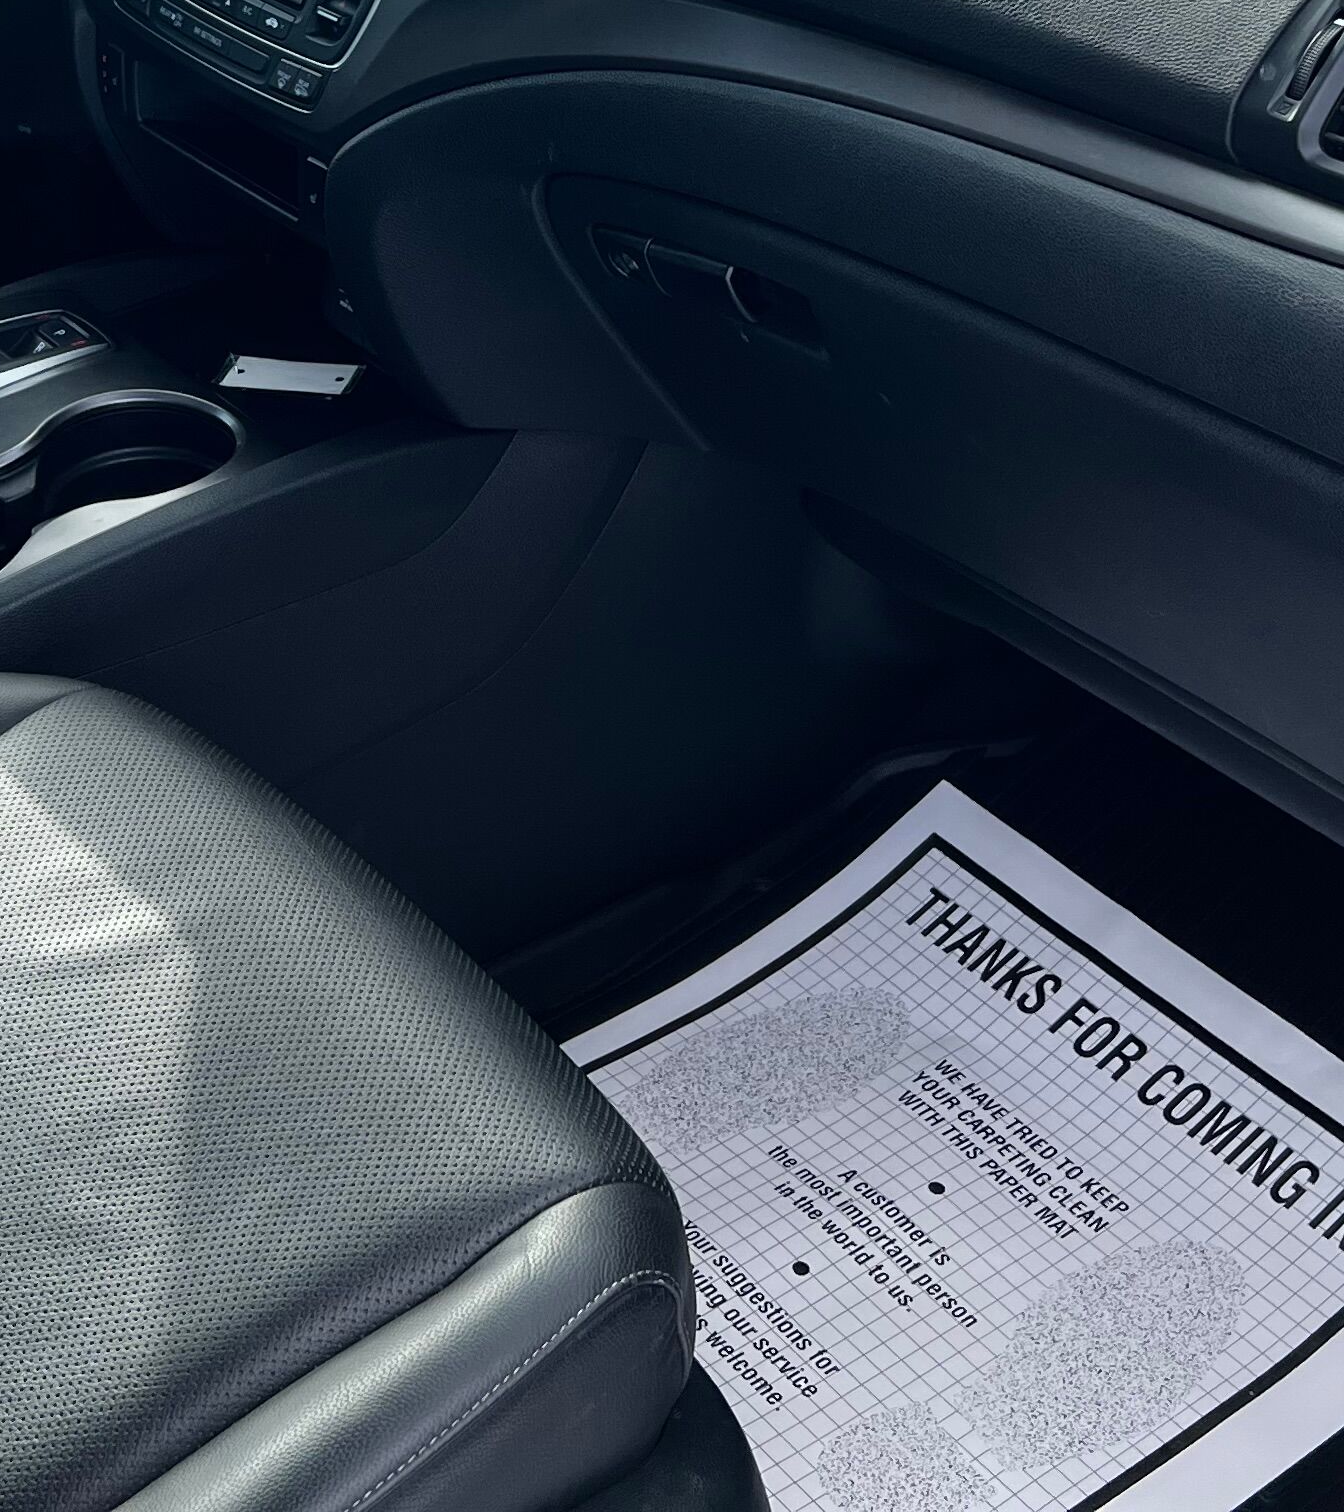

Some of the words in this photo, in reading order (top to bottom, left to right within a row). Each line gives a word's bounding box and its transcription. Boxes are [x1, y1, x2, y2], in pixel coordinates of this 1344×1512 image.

[53, 328, 66, 338] P
[906, 888, 1062, 1014] THANKS
[1048, 998, 1148, 1082] FOR
[1137, 1064, 1320, 1209] COMING
[898, 1090, 946, 1127] WITH
[941, 1124, 984, 1160] THIS
[978, 1158, 1038, 1208] PAPER
[1034, 1206, 1079, 1239] MAT
[912, 1070, 961, 1110] YOUR
[957, 1109, 1052, 1187] CARPETING
[1049, 1185, 1110, 1233] CLEAN
[934, 1059, 967, 1085] WE
[960, 1082, 1010, 1121] HAVE
[1005, 1116, 1058, 1160] TRIED
[1056, 1156, 1084, 1180] TO
[1080, 1177, 1130, 1213] KEEP
[768, 1145, 797, 1168] the
[795, 1168, 843, 1201] most
[836, 1198, 922, 1275] important
[911, 1273, 978, 1329] person
[773, 1180, 795, 1198] in
[792, 1196, 823, 1220] the
[821, 1219, 875, 1266] world
[868, 1264, 890, 1284] to
[888, 1284, 914, 1313] us.
[837, 1169, 858, 1183] A
[853, 1181, 932, 1247] customer
[929, 1246, 951, 1266] is
[705, 1330, 784, 1412] welcome.
[712, 1255, 813, 1351] suggestions
[808, 1348, 842, 1376] for
[723, 1308, 759, 1337] our
[752, 1337, 819, 1399] service
